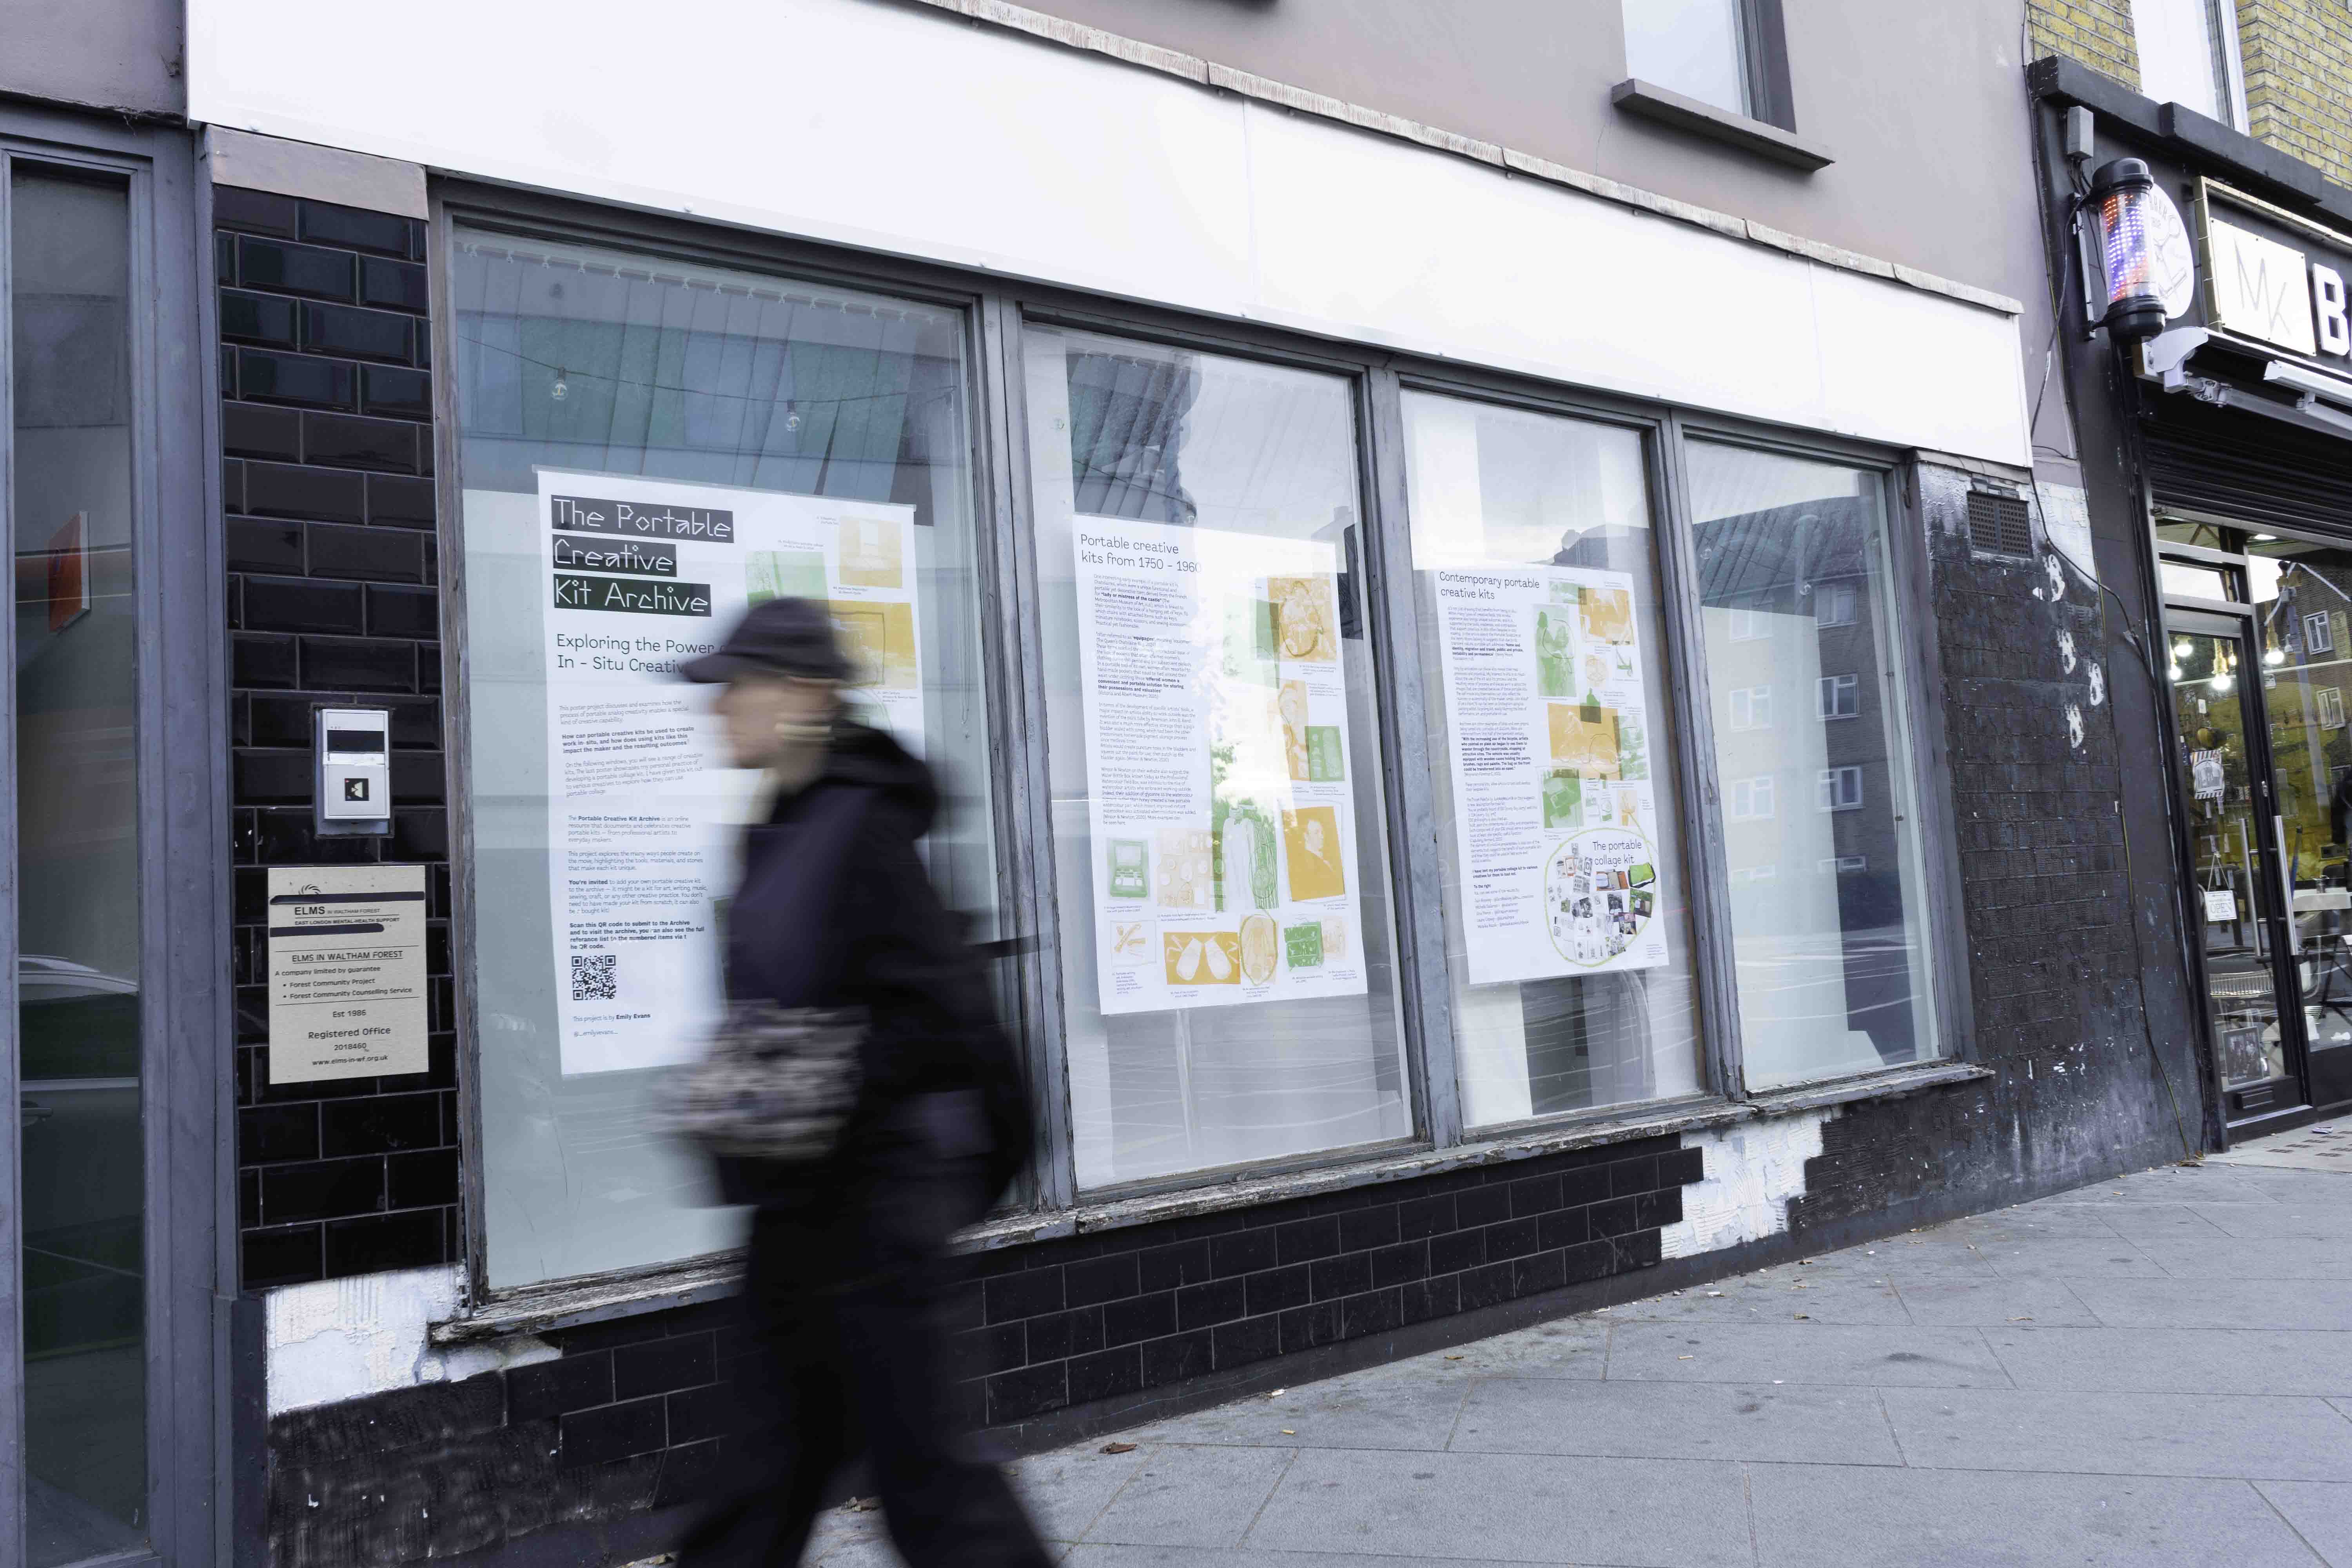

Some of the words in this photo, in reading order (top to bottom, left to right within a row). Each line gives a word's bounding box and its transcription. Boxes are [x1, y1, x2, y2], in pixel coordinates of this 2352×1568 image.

[2313, 263, 2352, 357] B
[554, 499, 604, 527] The
[617, 504, 731, 537] Portable
[1081, 534, 1129, 549] Portable
[1133, 542, 1179, 554] creative
[554, 539, 673, 571] Creative
[1082, 550, 1103, 564] kits
[1107, 553, 1135, 567] from
[1138, 557, 1163, 570] 1750
[1439, 571, 1502, 588] Contemporary
[1504, 578, 1540, 589] portable
[555, 579, 592, 604] Kit
[604, 583, 708, 612] Archive
[1441, 588, 1476, 598] creative
[1479, 588, 1495, 599] kits
[557, 633, 630, 654] Exploring
[635, 637, 661, 652] the
[666, 640, 715, 653] Power
[558, 655, 574, 668] In
[593, 657, 624, 671] Situ
[629, 658, 689, 673] Creativ
[563, 746, 583, 755] impact
[633, 741, 659, 750] resulting
[1593, 841, 1606, 850] The
[1608, 840, 1642, 852] portable
[1595, 855, 1622, 867] collage
[1624, 853, 1635, 863] kit
[294, 906, 325, 915] ELMS
[308, 1028, 359, 1039] Registered
[362, 1027, 391, 1035] Office
[312, 1054, 388, 1066] www.elms-in-wf.org.uk
